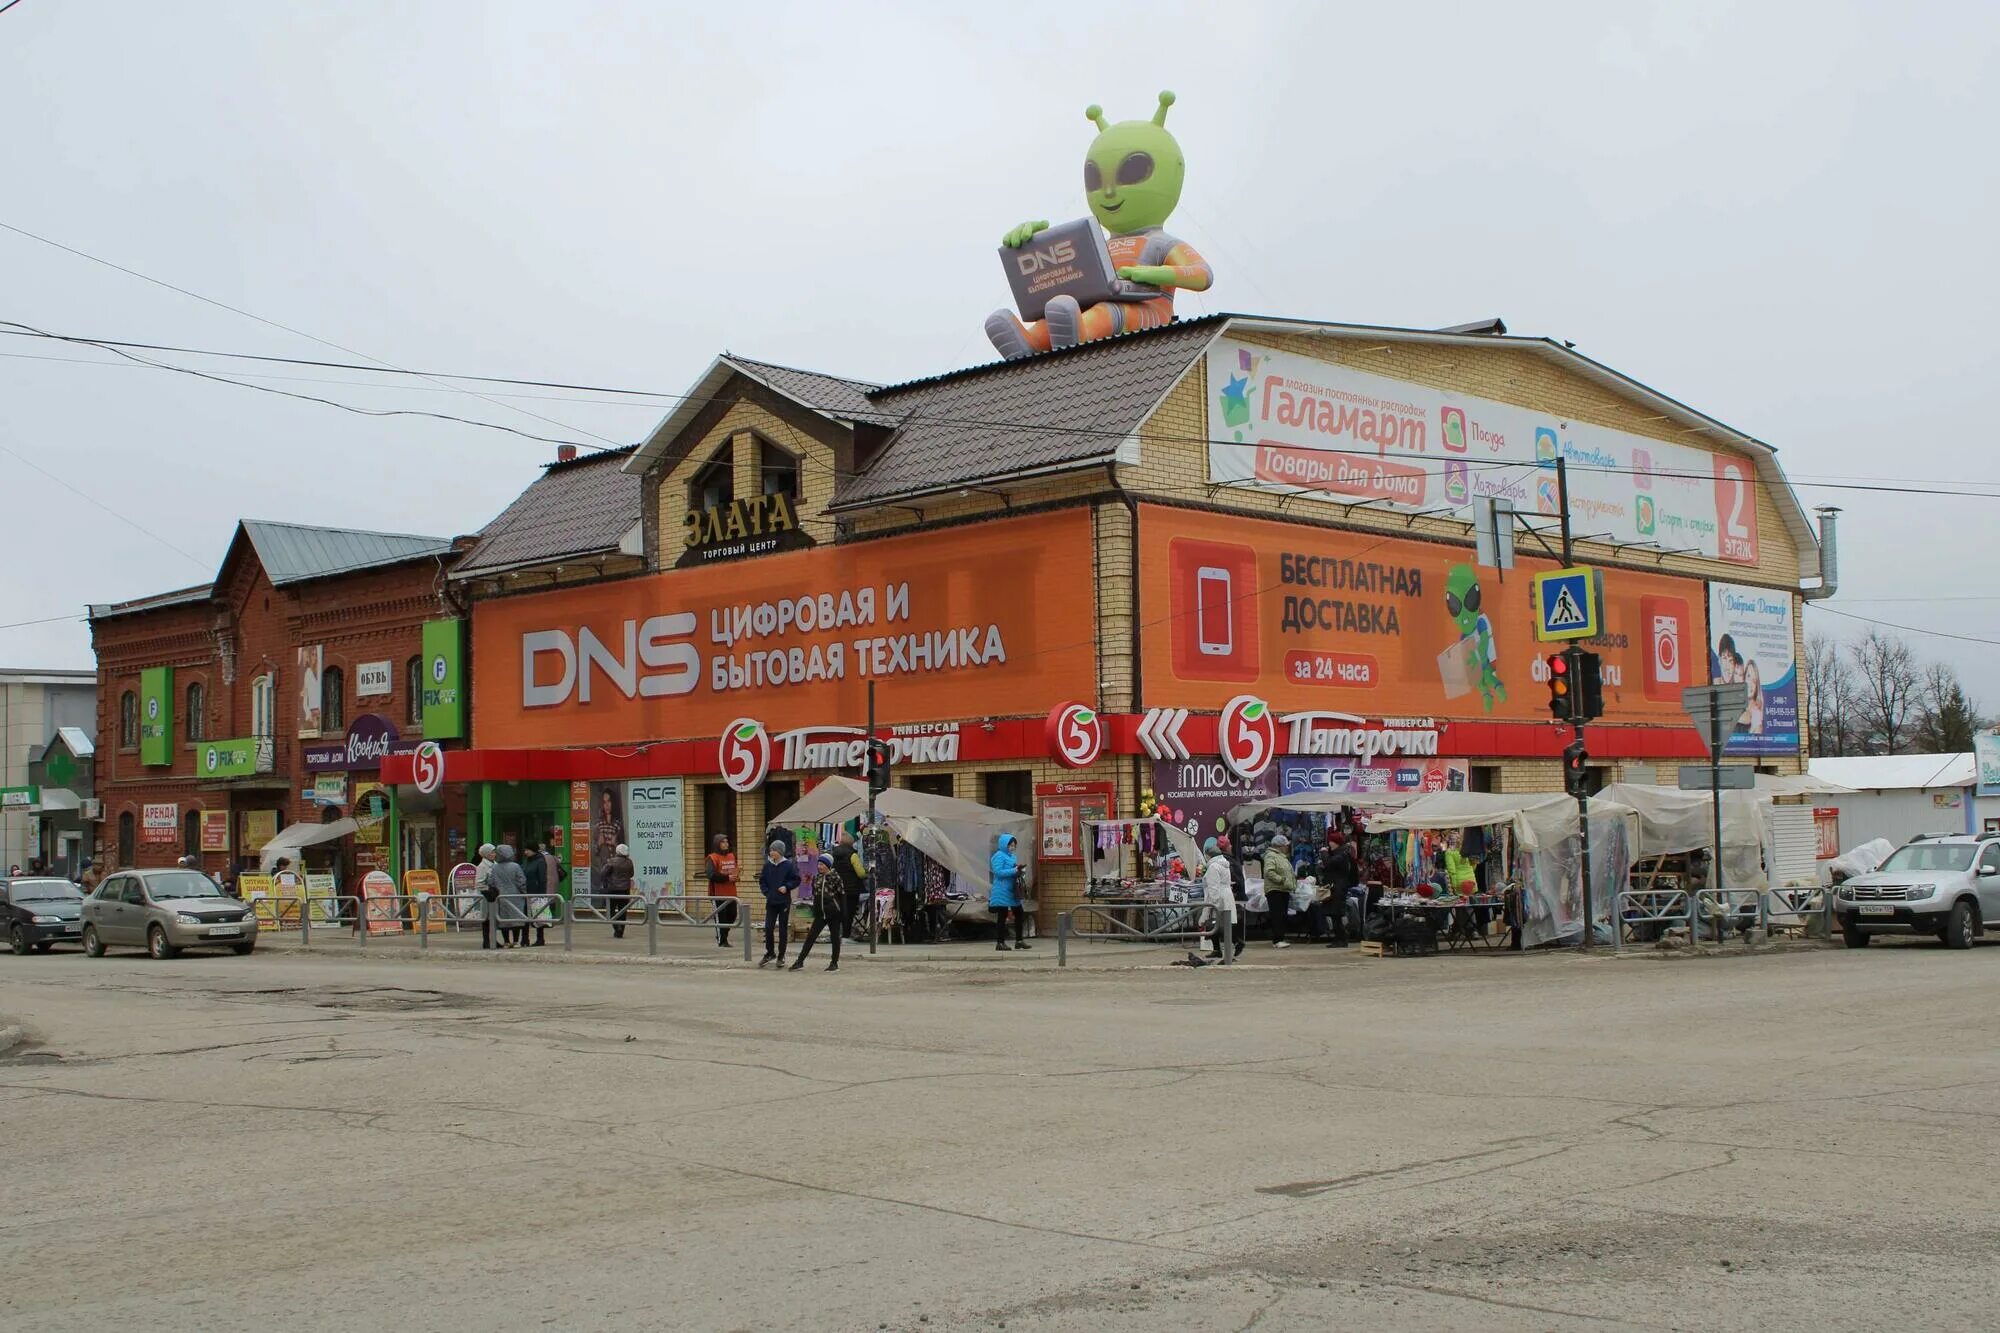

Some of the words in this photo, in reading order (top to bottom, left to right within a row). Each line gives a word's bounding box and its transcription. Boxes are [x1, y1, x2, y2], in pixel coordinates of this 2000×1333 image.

[1017, 240, 1076, 276] DNS
[1028, 279, 1055, 294] БЫТОВАЯ
[1056, 271, 1084, 288] ТЕХНИКА
[1033, 268, 1067, 284] ЦИФРОВАЯ
[1285, 378, 1323, 395] магазин
[1325, 387, 1379, 408] постоянных
[1380, 398, 1426, 419] распродаж
[1261, 375, 1426, 459] Галамарт
[1471, 421, 1506, 454] Посуда
[1263, 446, 1334, 482] Товары
[1337, 459, 1368, 488] для
[1373, 468, 1419, 495] дома
[1723, 464, 1748, 538] 2
[683, 492, 793, 547] ЗЛАТА
[703, 544, 745, 560] ТОРГОВЫЙ
[750, 540, 777, 553] ЦЕНТР
[1725, 537, 1753, 560] этаж
[1280, 552, 1421, 597] БЕСПЛАТНАЯ
[711, 587, 875, 648] ЦИФРОВАЯ
[886, 582, 909, 622] И
[1282, 596, 1400, 636] ДОСТАВКА
[522, 611, 700, 707] DNS
[711, 642, 844, 690] БЫТОВАЯ
[853, 624, 1006, 677] ТЕХНИКА
[361, 671, 387, 685] ОБУВЬ
[1295, 660, 1311, 679] за
[1316, 657, 1333, 679] 24
[1338, 662, 1370, 682] часа
[892, 722, 960, 735] УНИВЕРСАМ
[1383, 717, 1435, 728] УНИВЕРСАМ
[347, 731, 390, 763] Ксения
[775, 725, 959, 776] Пятеочка
[1279, 711, 1438, 766] Пятерочка
[307, 752, 330, 765] ТОРГОВЫЙ
[331, 753, 344, 763] ДОМ
[1285, 767, 1351, 790] RCF
[1402, 773, 1418, 782] ЭТАЖ
[632, 787, 676, 801] RCF
[1168, 790, 1195, 798] КОСМЕТИКА
[145, 807, 175, 819] АРЕНДА
[636, 819, 674, 829] Коллекция
[647, 840, 663, 850] 2019
[643, 866, 648, 875] 3
[648, 865, 668, 875] ЭТАЖ
